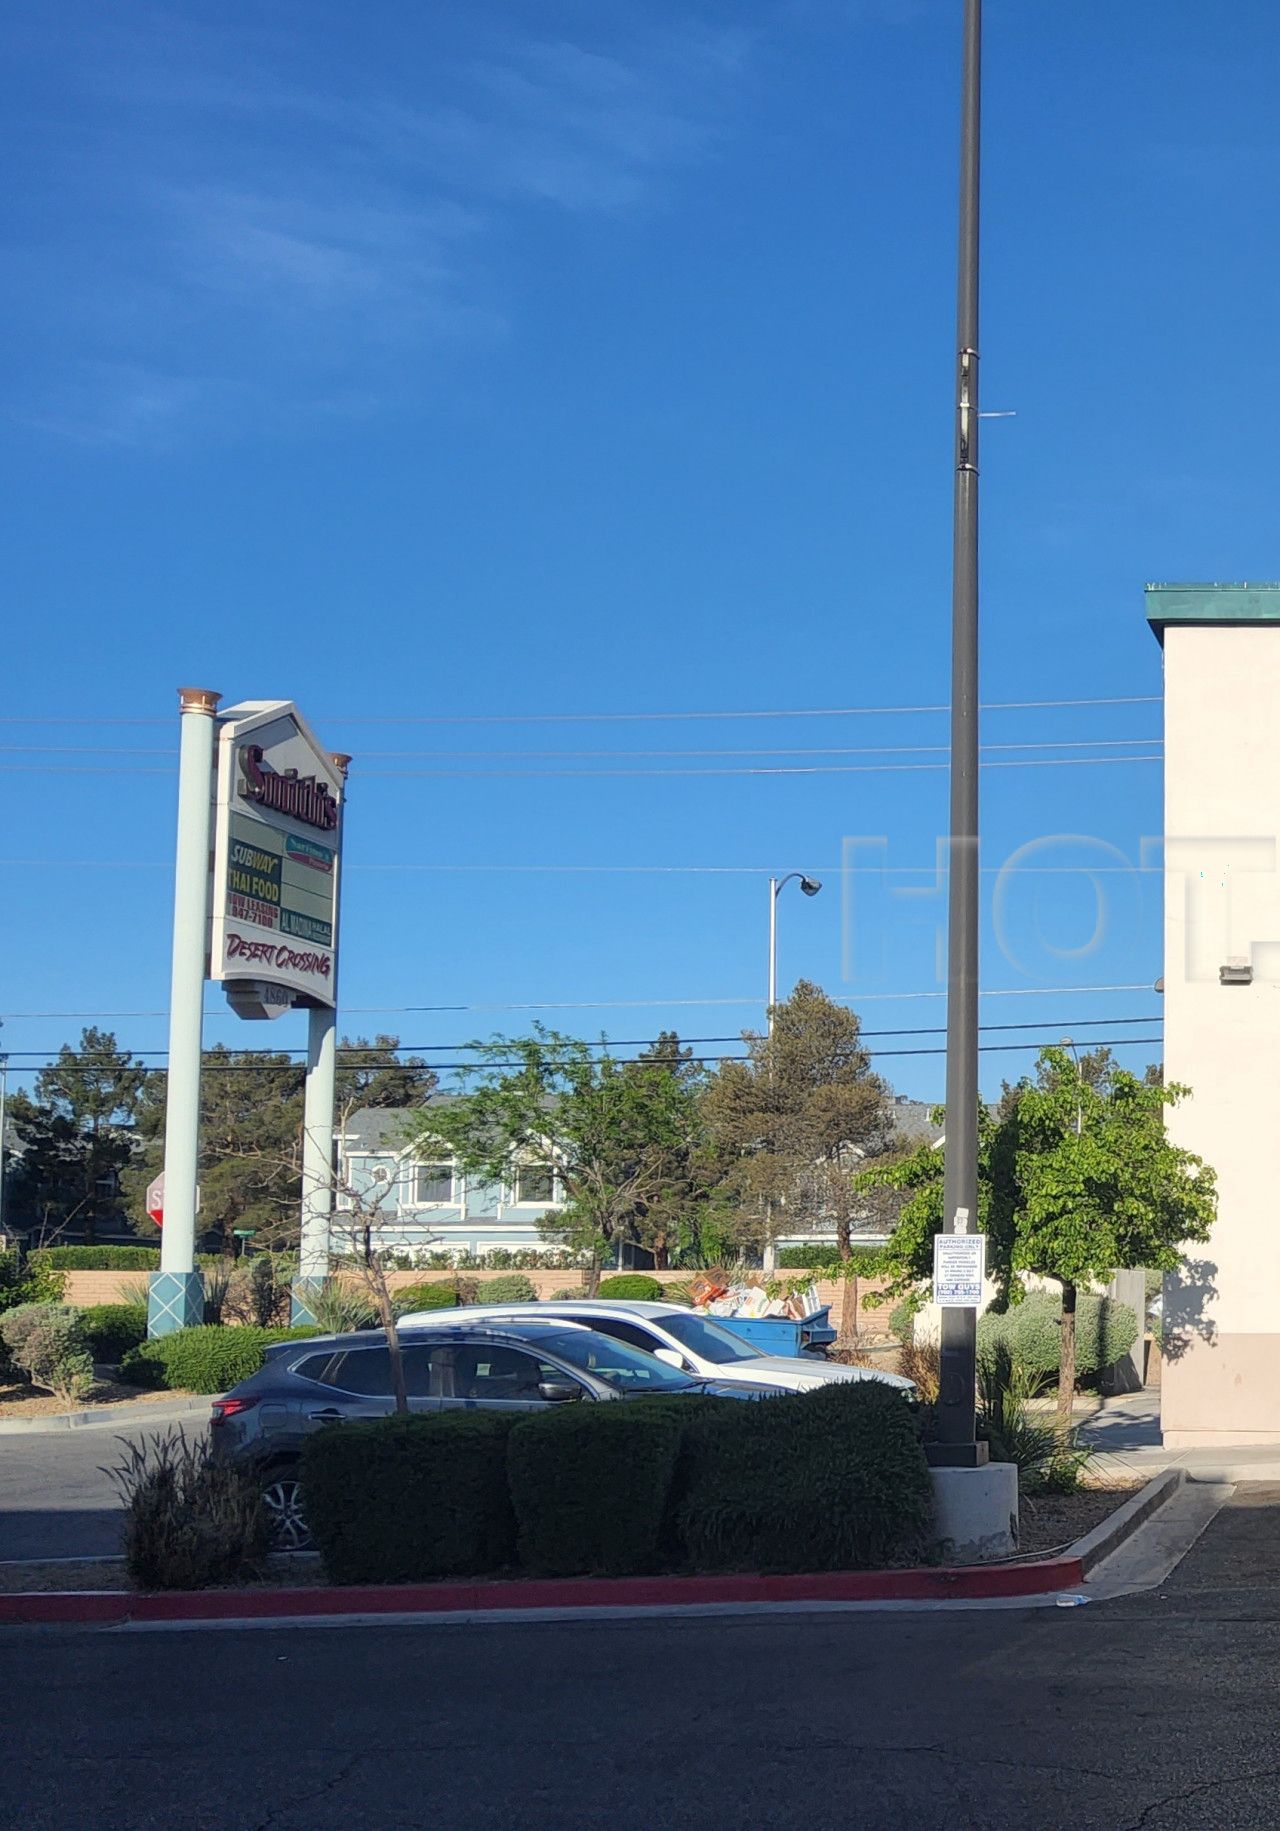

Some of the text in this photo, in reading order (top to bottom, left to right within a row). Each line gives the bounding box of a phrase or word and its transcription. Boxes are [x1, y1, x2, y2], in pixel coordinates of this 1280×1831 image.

[237, 744, 337, 831] Smith's
[229, 844, 278, 874] SUBWAY
[227, 867, 279, 902] THAI FOOD
[246, 897, 279, 919] LEASING
[226, 933, 277, 966] DESERT
[275, 945, 331, 980] CROSSING
